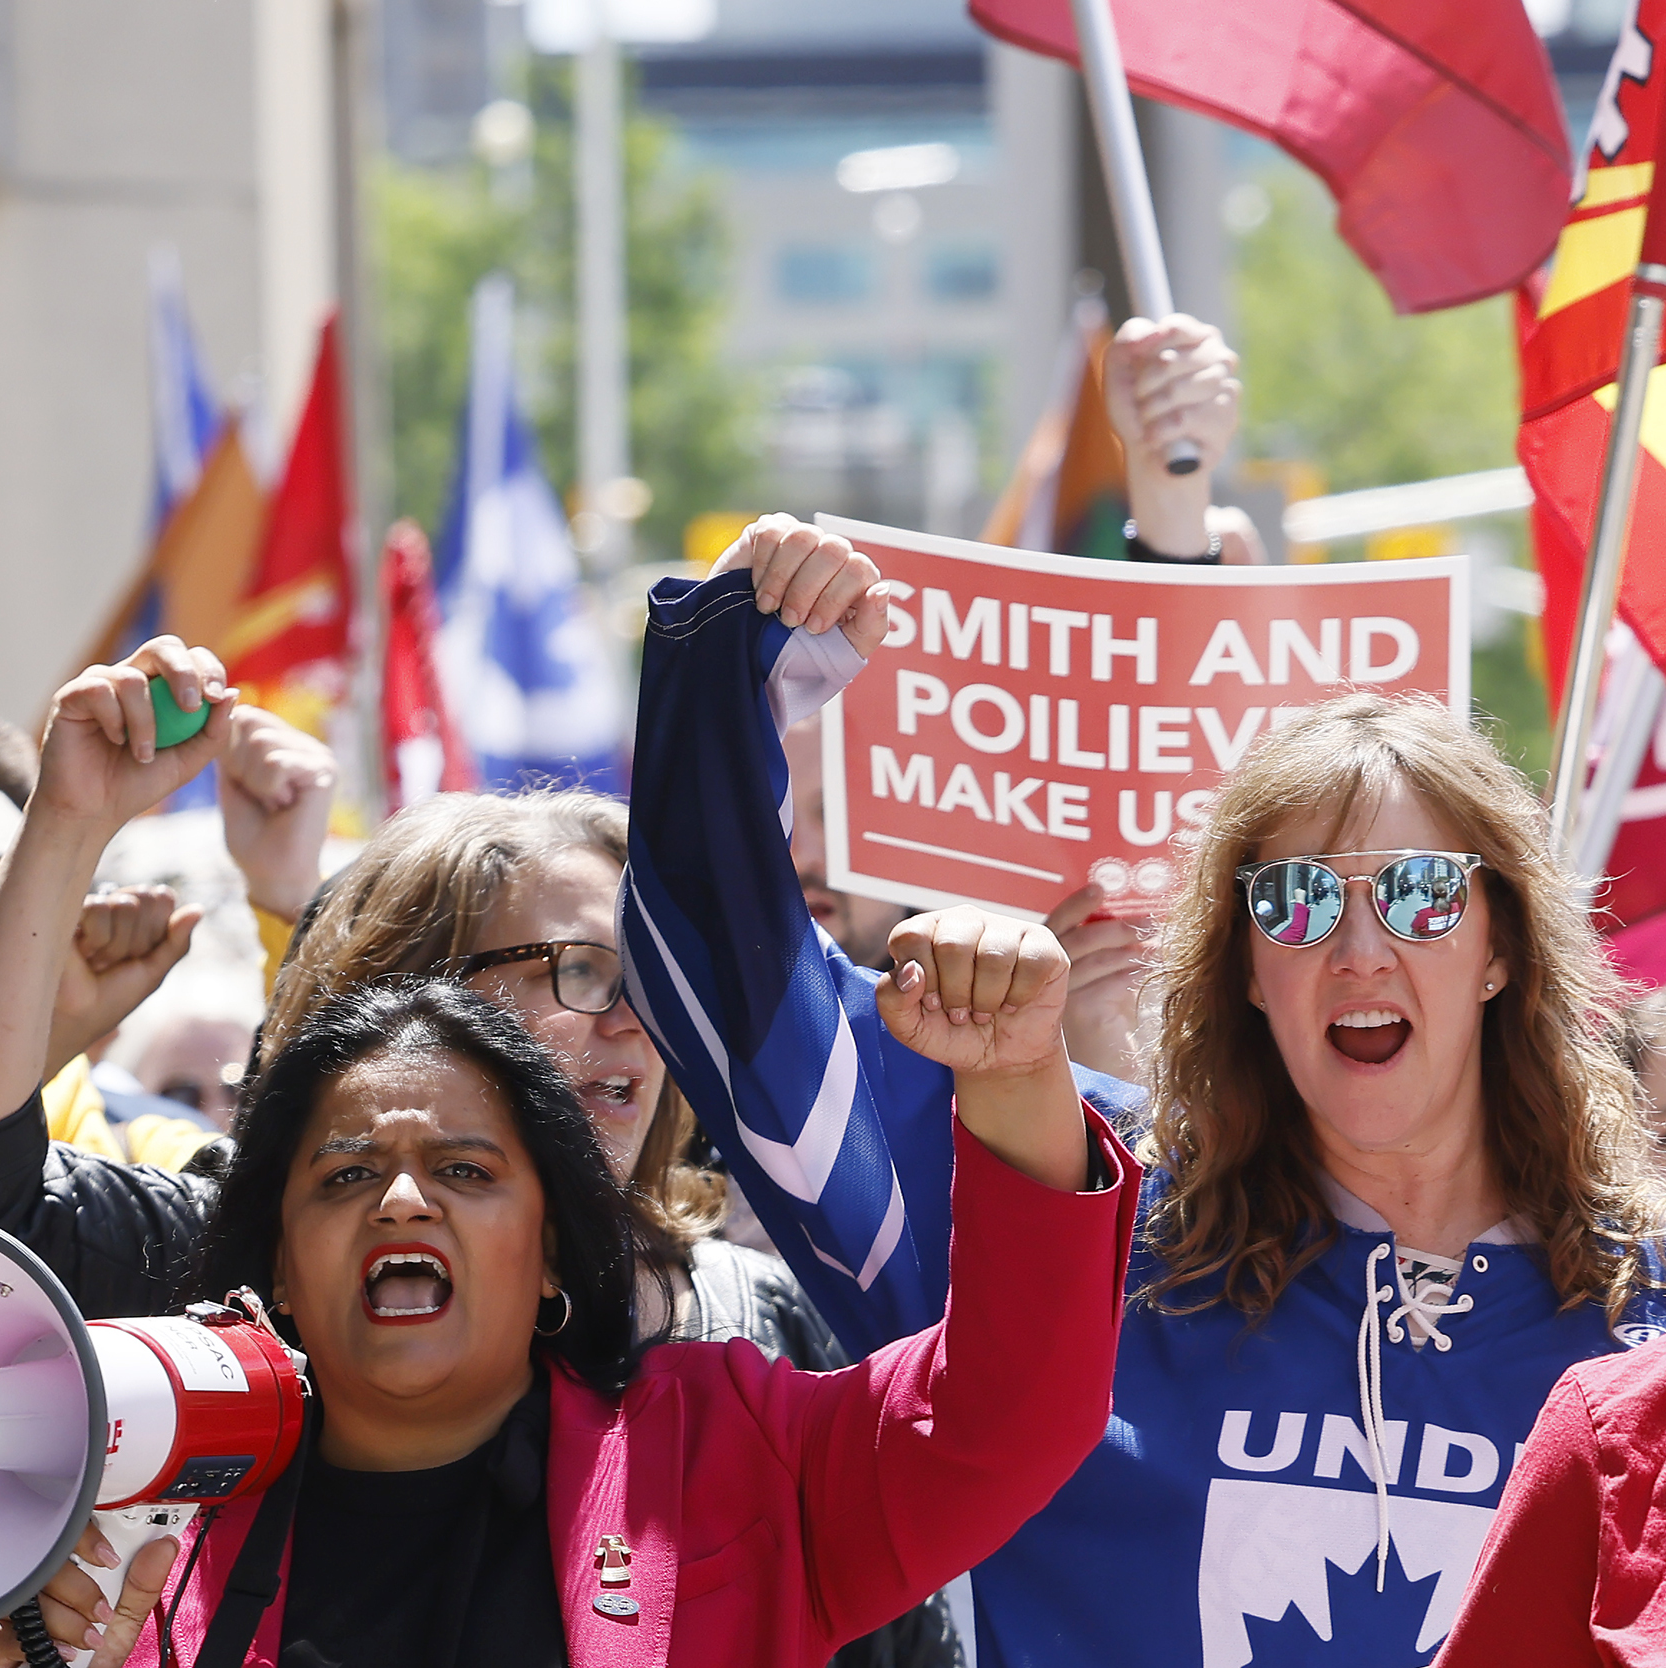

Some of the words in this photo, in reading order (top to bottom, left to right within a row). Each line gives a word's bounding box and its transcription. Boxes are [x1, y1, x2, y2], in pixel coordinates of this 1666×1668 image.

[880, 579, 1158, 685] SMITH
[1188, 615, 1420, 686] AND
[895, 668, 1310, 773] POILIEV
[869, 745, 1091, 841] MAKE
[1216, 1410, 1524, 1494] UND
